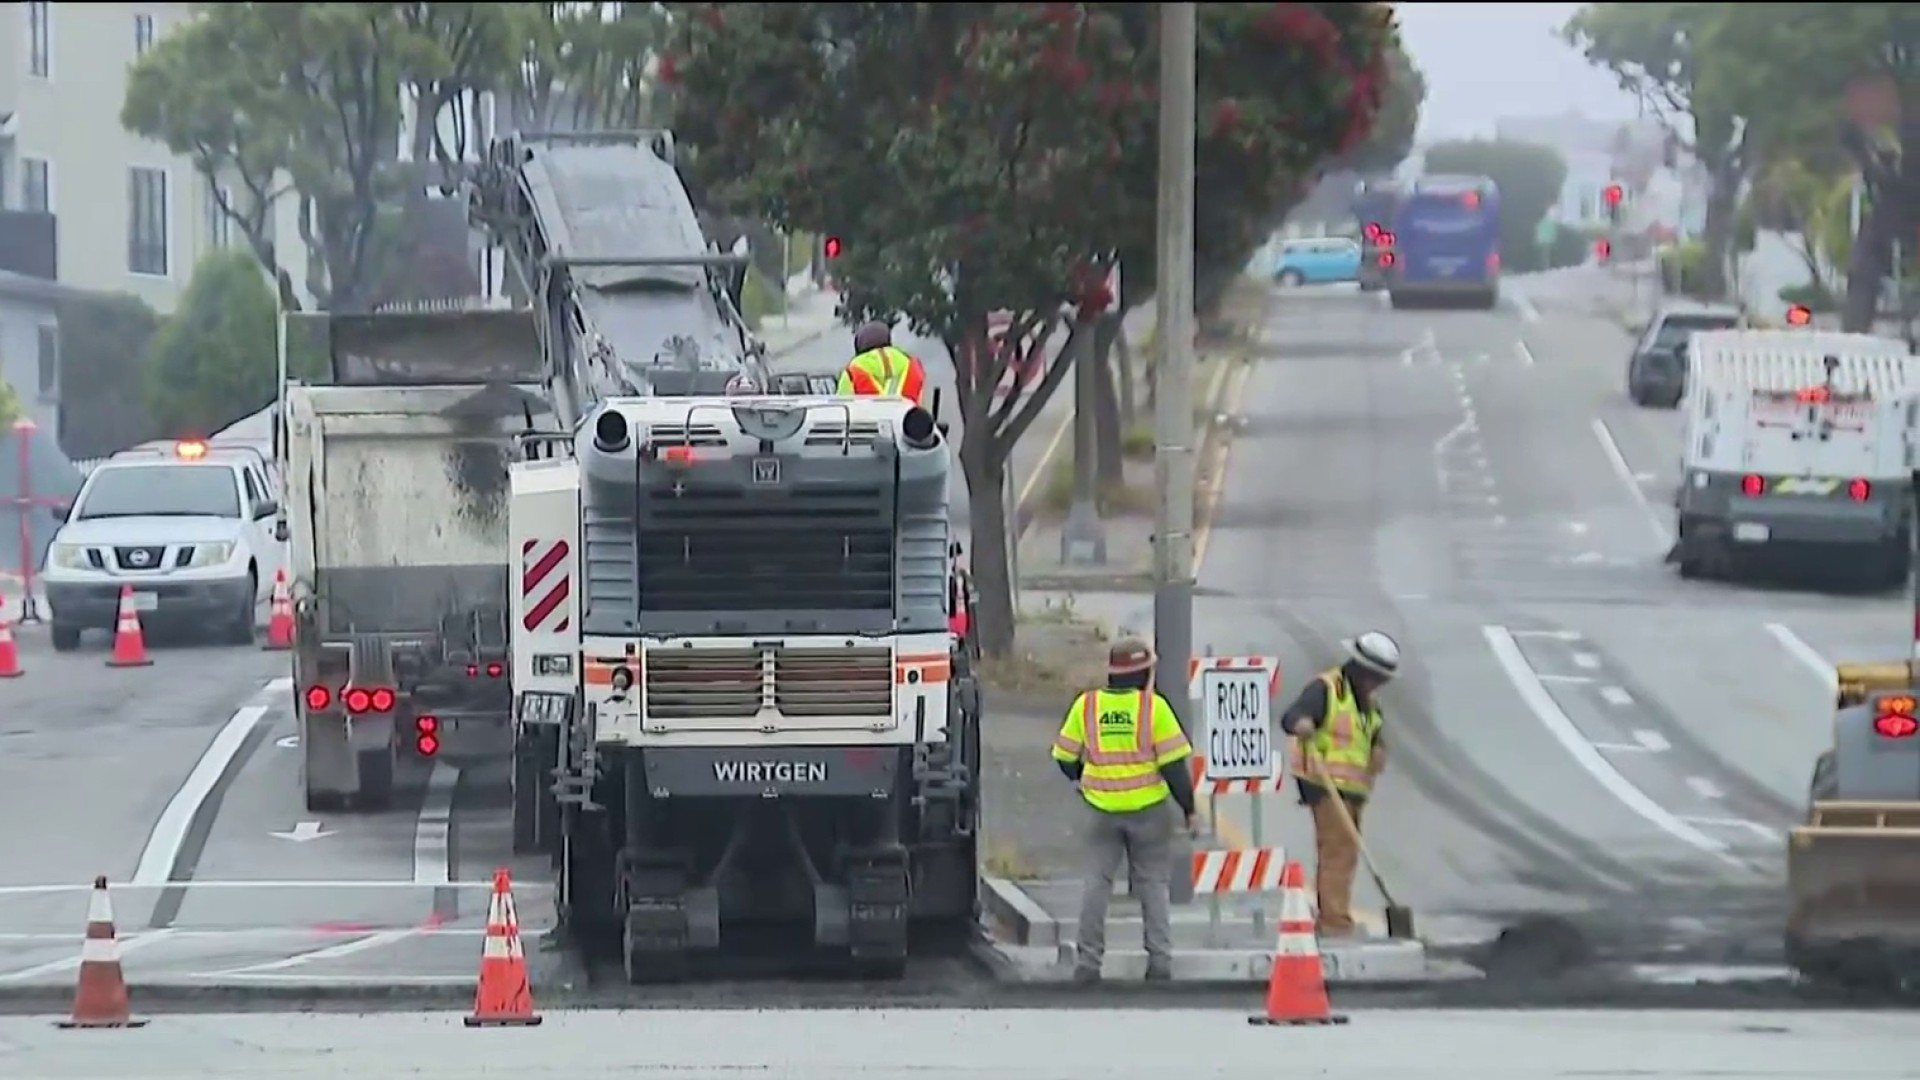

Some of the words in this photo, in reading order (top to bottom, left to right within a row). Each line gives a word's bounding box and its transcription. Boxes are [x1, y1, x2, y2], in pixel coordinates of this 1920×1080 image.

[1217, 682, 1260, 720] ROAD
[1211, 728, 1267, 767] CLOSED
[713, 761, 826, 781] WIRTGEN
